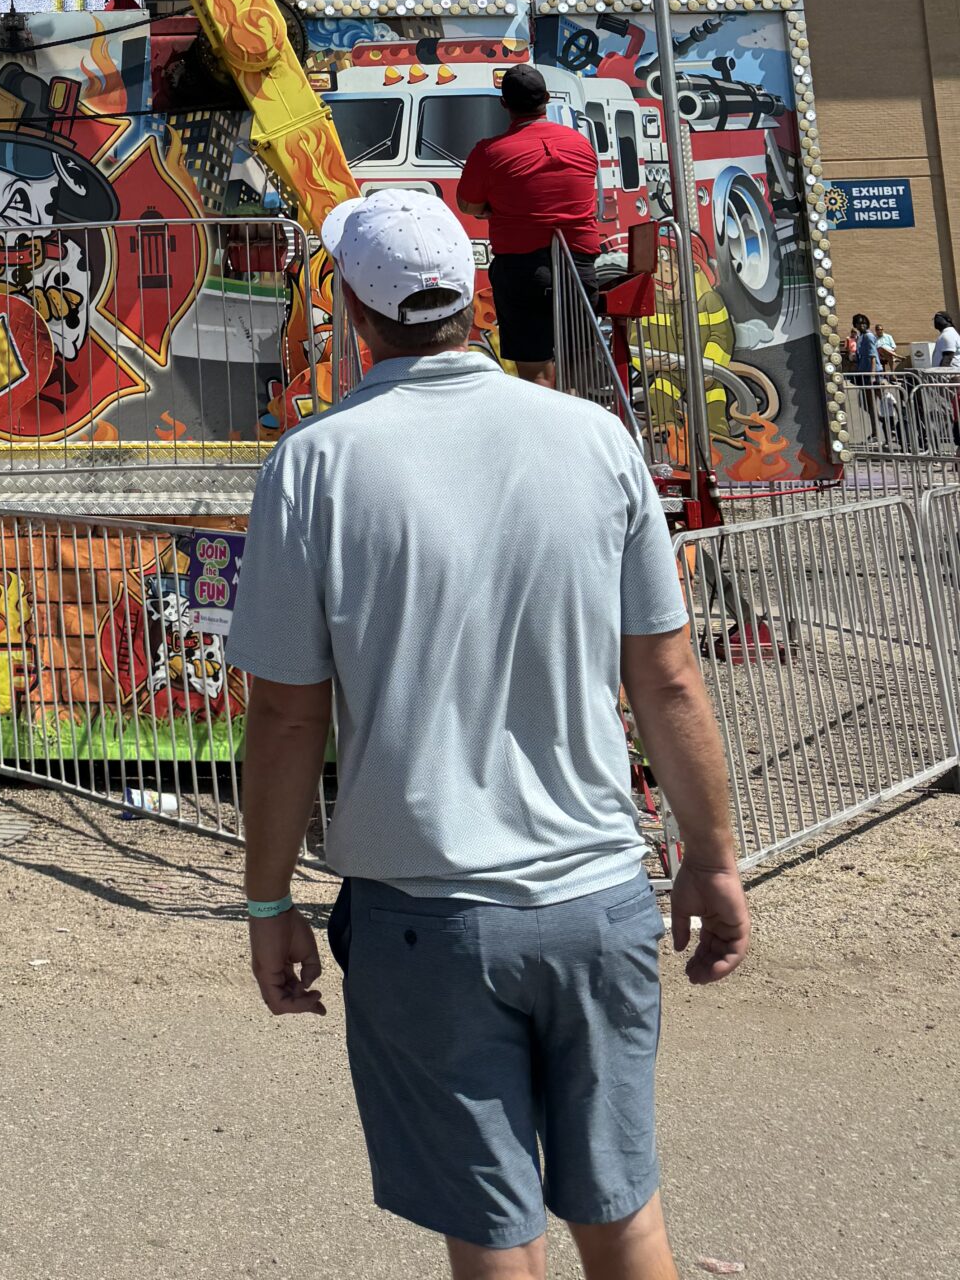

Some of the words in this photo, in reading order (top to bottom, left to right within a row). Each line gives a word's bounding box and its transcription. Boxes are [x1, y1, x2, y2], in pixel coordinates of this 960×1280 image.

[852, 185, 905, 197] EXHIBIT
[853, 198, 897, 209] SPACE
[854, 210, 900, 221] INSIDE
[199, 543, 228, 561] JOIN
[206, 565, 217, 577] the
[198, 581, 226, 602] FUN
